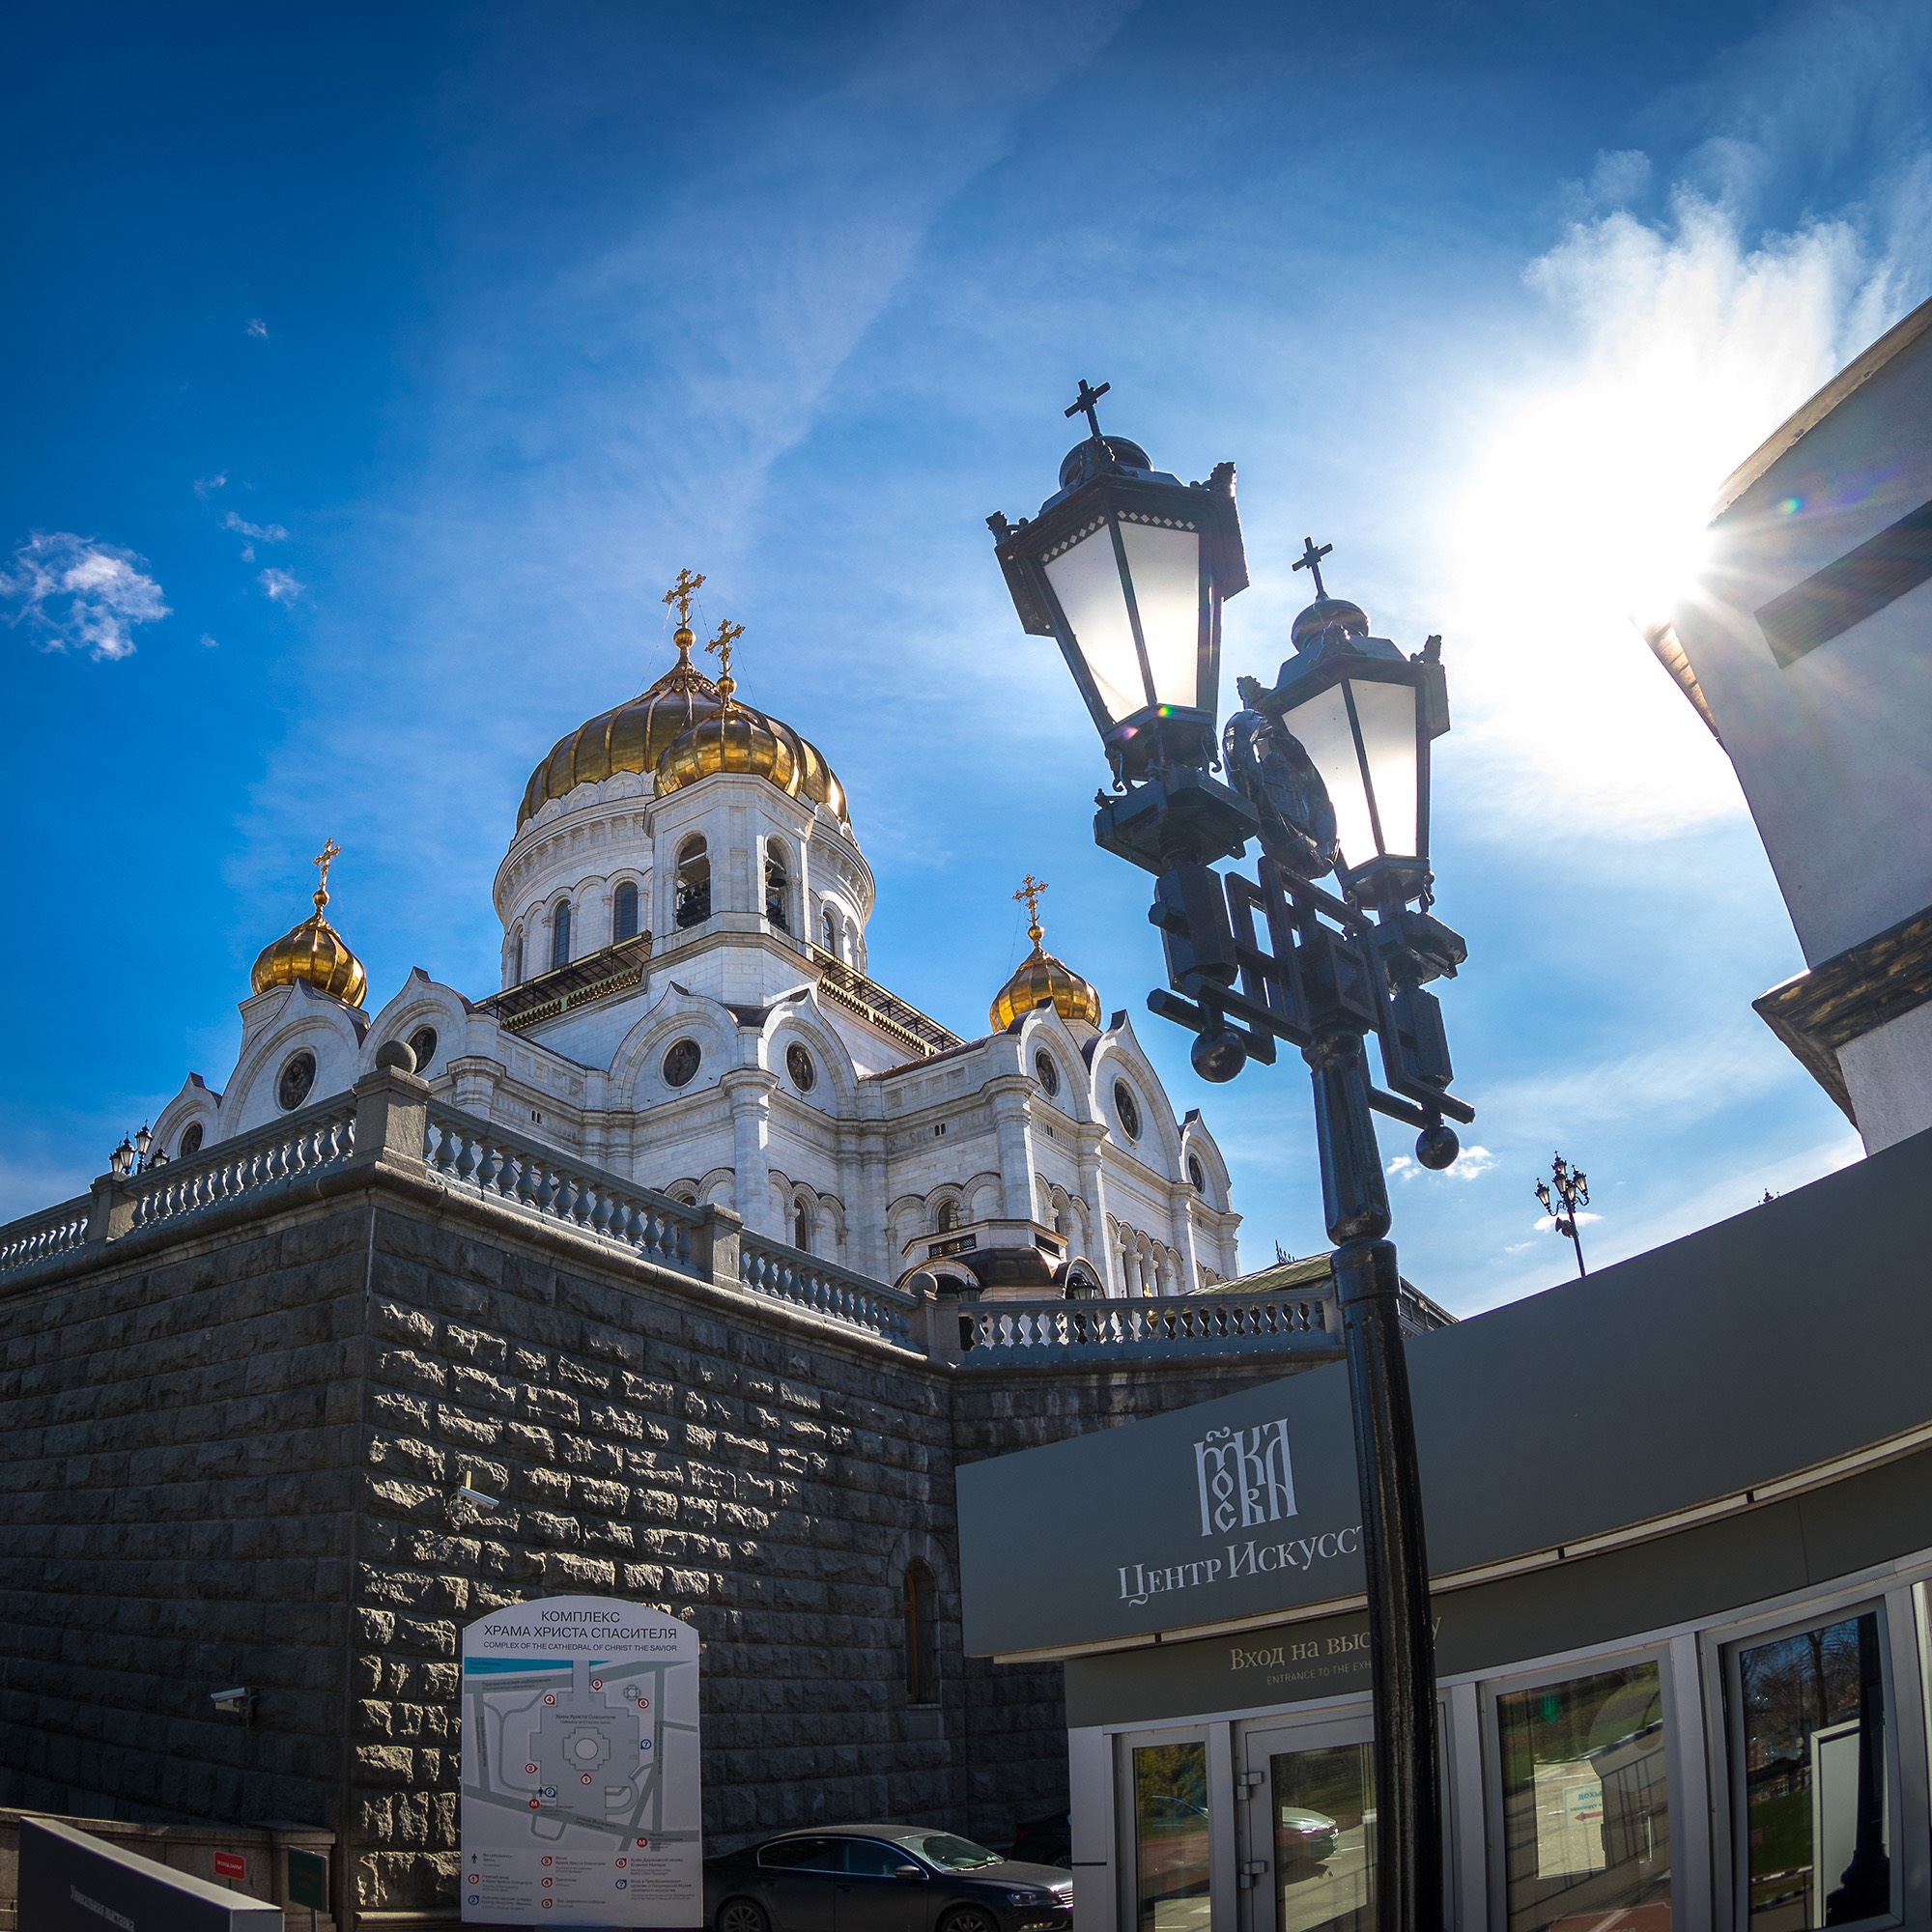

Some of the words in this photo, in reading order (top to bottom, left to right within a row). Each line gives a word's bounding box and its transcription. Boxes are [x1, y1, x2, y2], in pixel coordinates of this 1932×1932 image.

[541, 1610, 620, 1623] КОМПЛЕКС
[484, 1625, 531, 1636] ХРАМА
[534, 1626, 588, 1638] ХРИСТА
[591, 1628, 677, 1639] СПАСИТЕЛЯ
[1231, 1647, 1285, 1670] Вход
[1292, 1640, 1319, 1662] на
[1266, 1667, 1316, 1686] ENTRANCE
[1318, 1665, 1330, 1678] TO
[1332, 1662, 1350, 1675] THE
[1352, 1660, 1372, 1671] EXH
